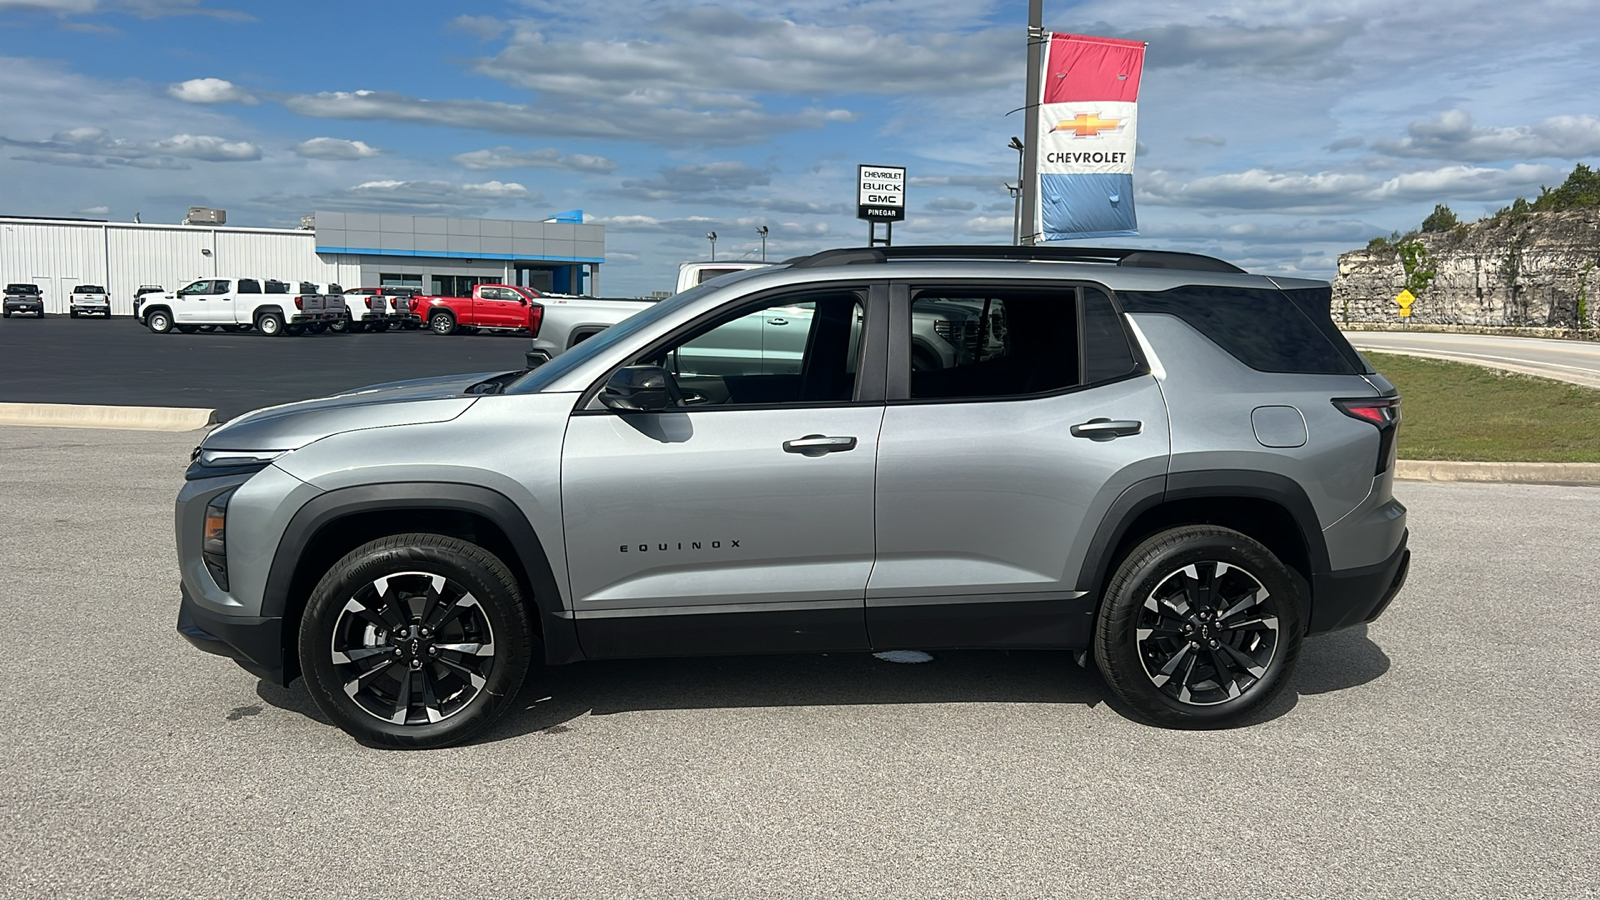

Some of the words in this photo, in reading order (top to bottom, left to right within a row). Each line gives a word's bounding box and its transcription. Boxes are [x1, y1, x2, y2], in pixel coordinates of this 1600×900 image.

[1047, 152, 1126, 164] CHEVROLET
[864, 171, 902, 179] CHEVROLET
[863, 183, 902, 191] BUICK
[868, 195, 896, 203] GMC
[620, 540, 740, 552] EQUINOX
